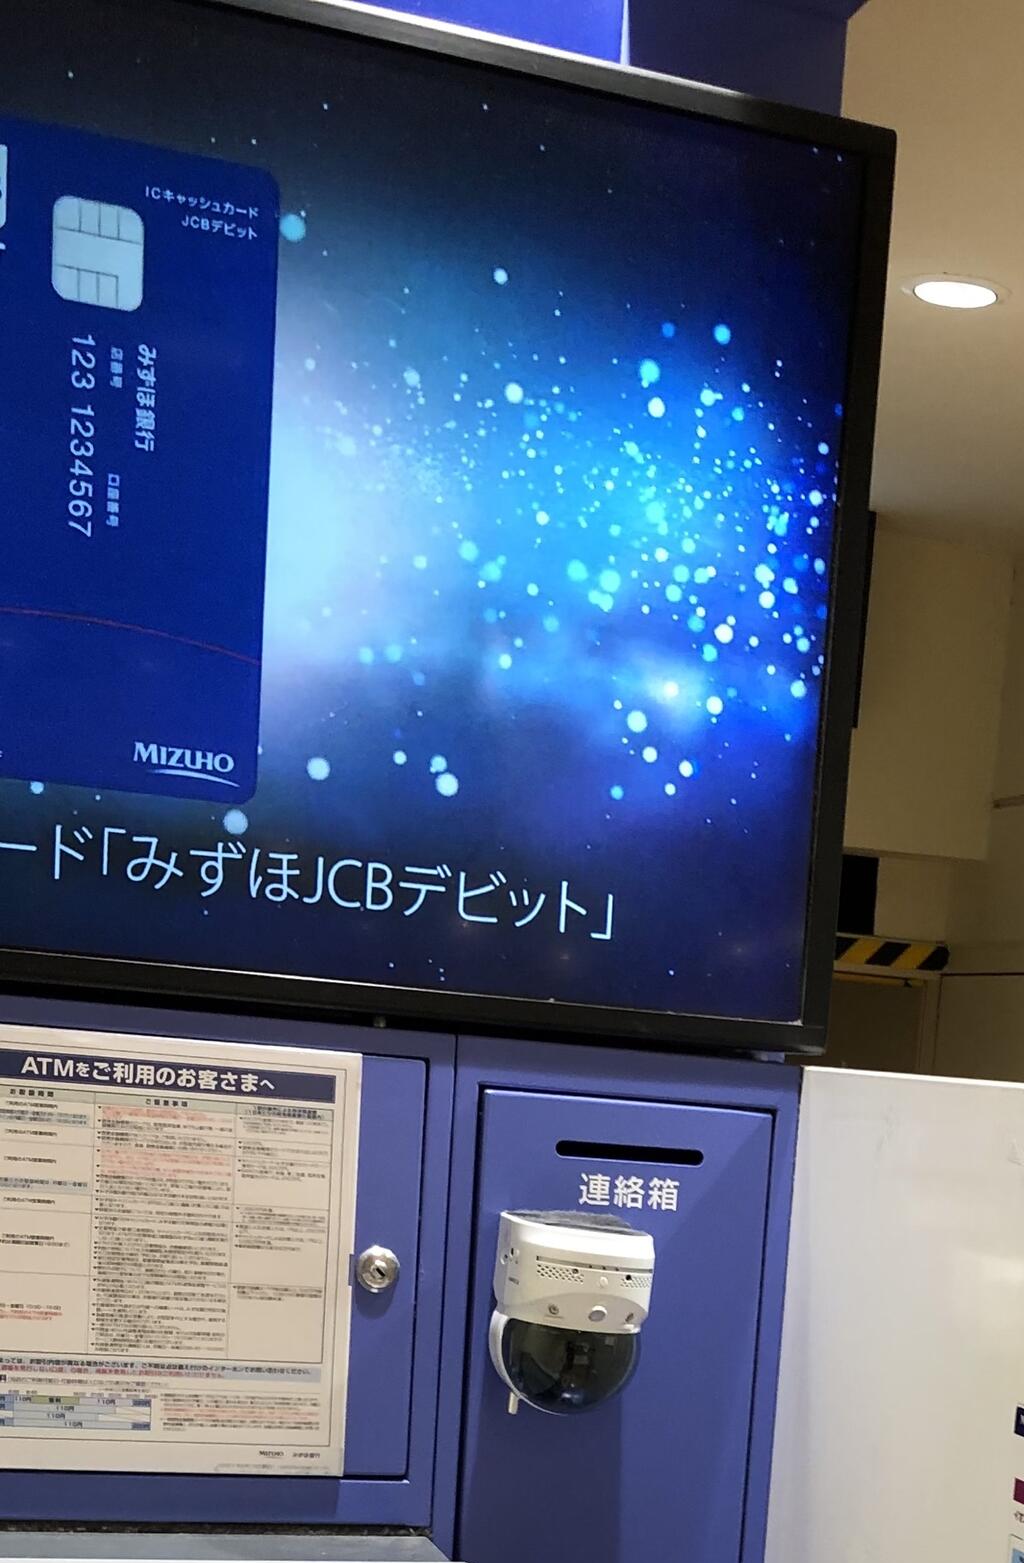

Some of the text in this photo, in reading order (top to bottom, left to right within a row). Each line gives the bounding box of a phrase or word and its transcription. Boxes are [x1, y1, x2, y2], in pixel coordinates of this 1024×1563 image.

[145, 186, 259, 219] ICキャッシュカード
[181, 215, 257, 240] JCBデビット
[135, 343, 157, 451] みずほ銀行
[68, 334, 96, 538] 123 1234567
[134, 741, 234, 775] MIZUHO
[21, 1056, 275, 1093] ATMをご利用のお客さまへ
[578, 1173, 680, 1212] 連絡箱
